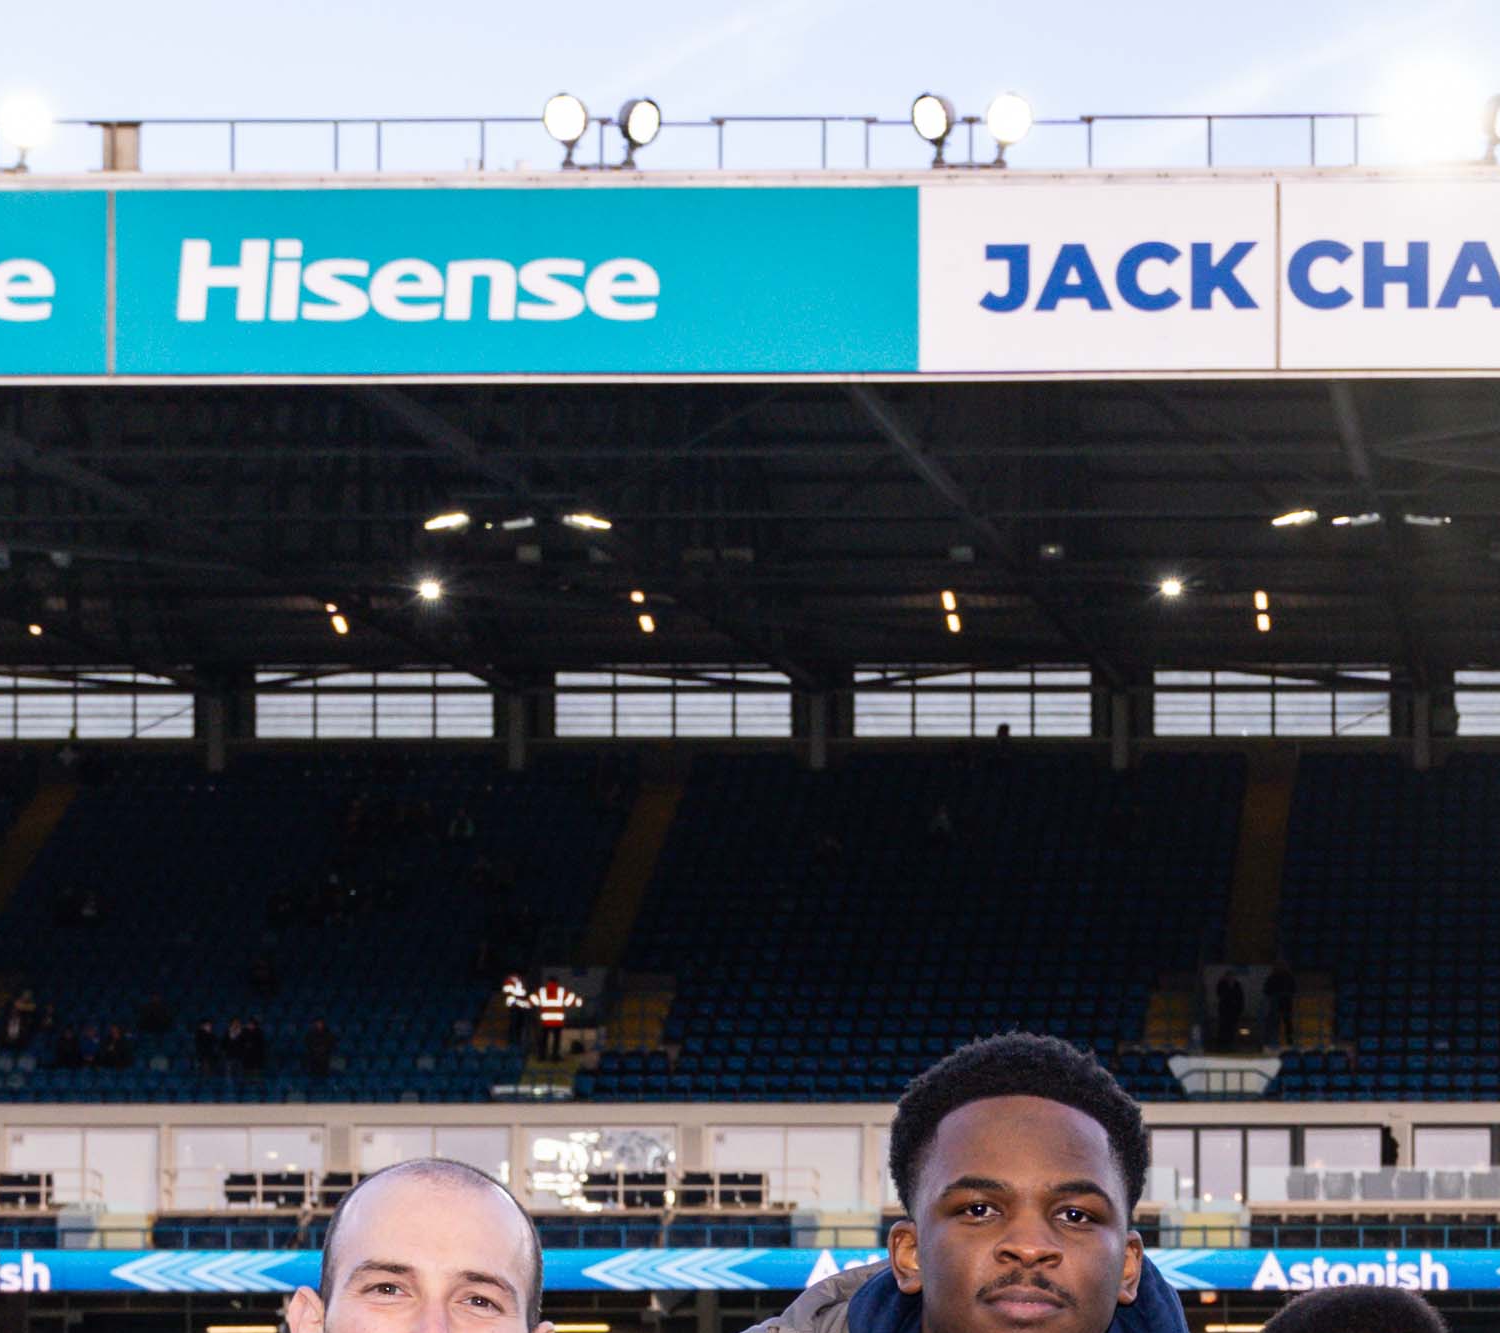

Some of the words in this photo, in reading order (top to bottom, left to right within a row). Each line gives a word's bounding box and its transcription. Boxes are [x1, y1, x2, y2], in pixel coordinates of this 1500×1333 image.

[176, 238, 660, 322] Hisense
[980, 242, 1258, 312] JACK
[1252, 1250, 1449, 1291] Astonish
